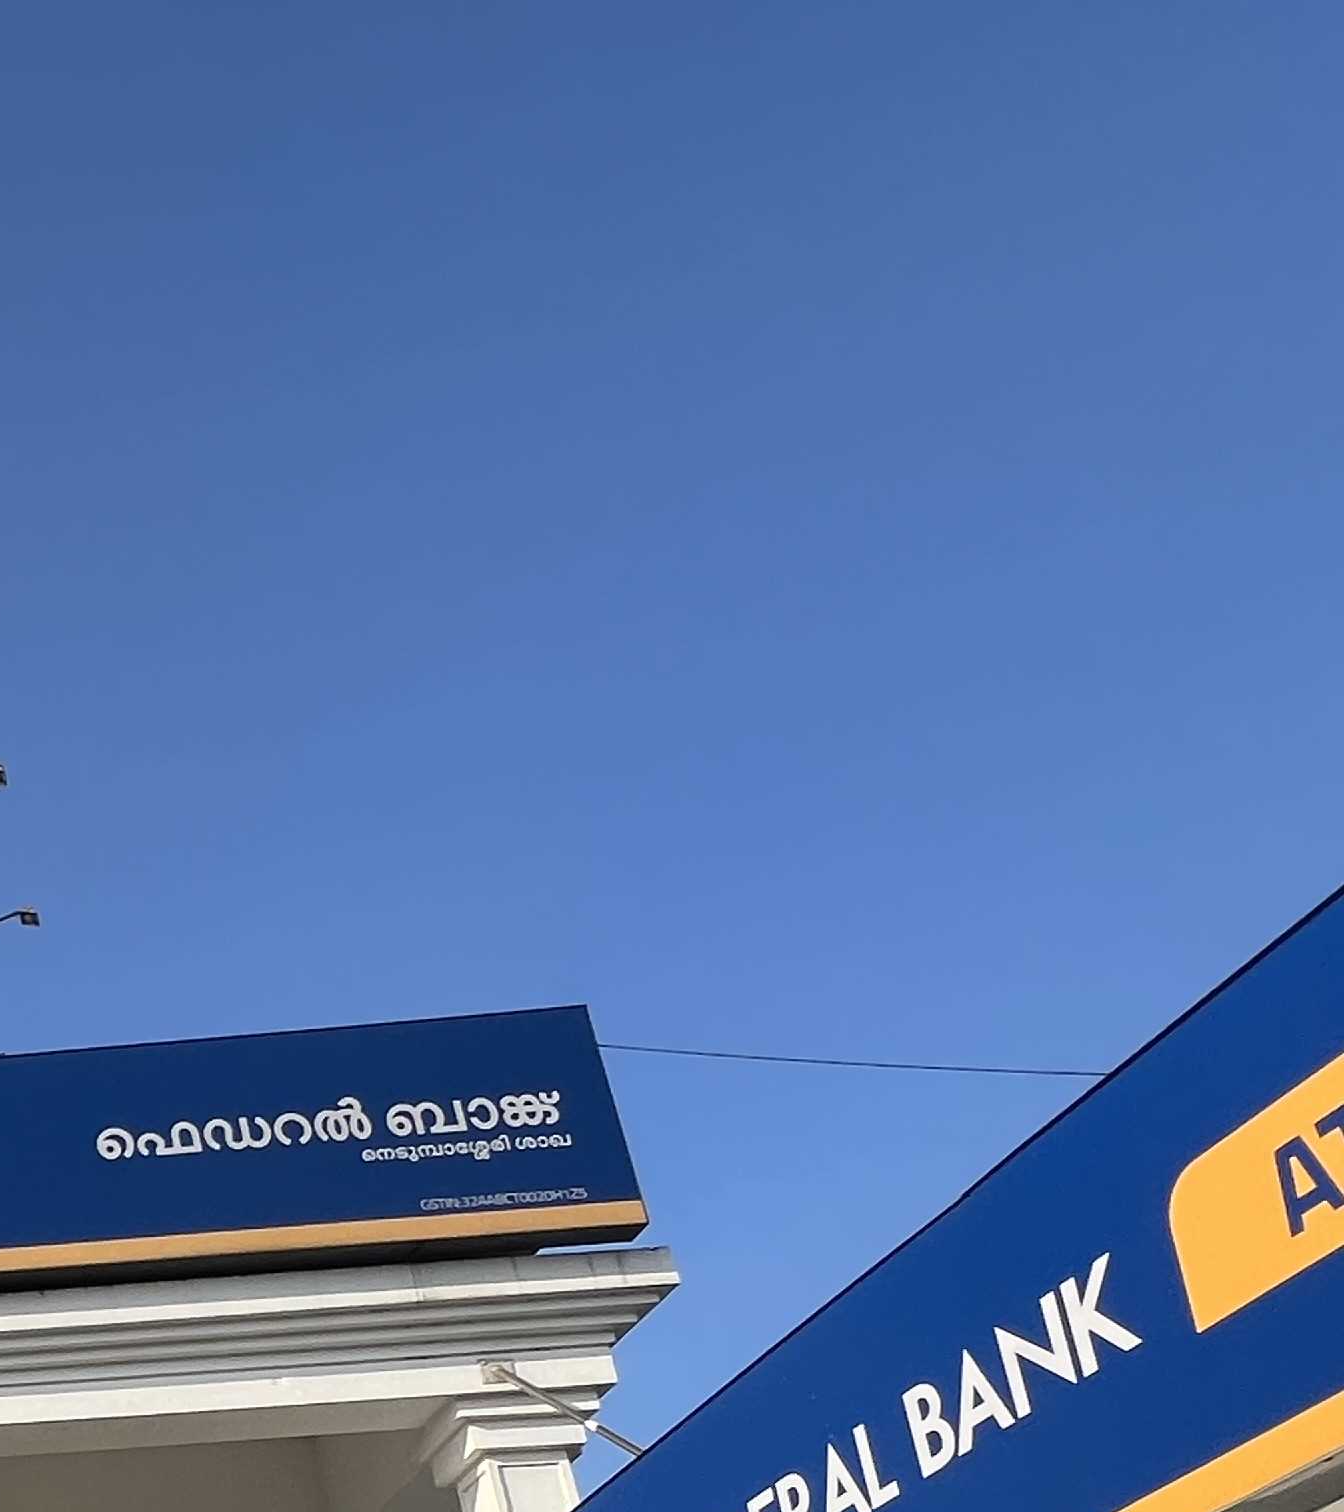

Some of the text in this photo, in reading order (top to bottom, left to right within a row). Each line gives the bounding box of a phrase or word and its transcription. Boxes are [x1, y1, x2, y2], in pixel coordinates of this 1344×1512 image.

[96, 1089, 561, 1162] ഫെഡറൽ ബാങ്ക്
[514, 1132, 572, 1150] ശാഖ
[901, 1251, 1144, 1480] BANK
